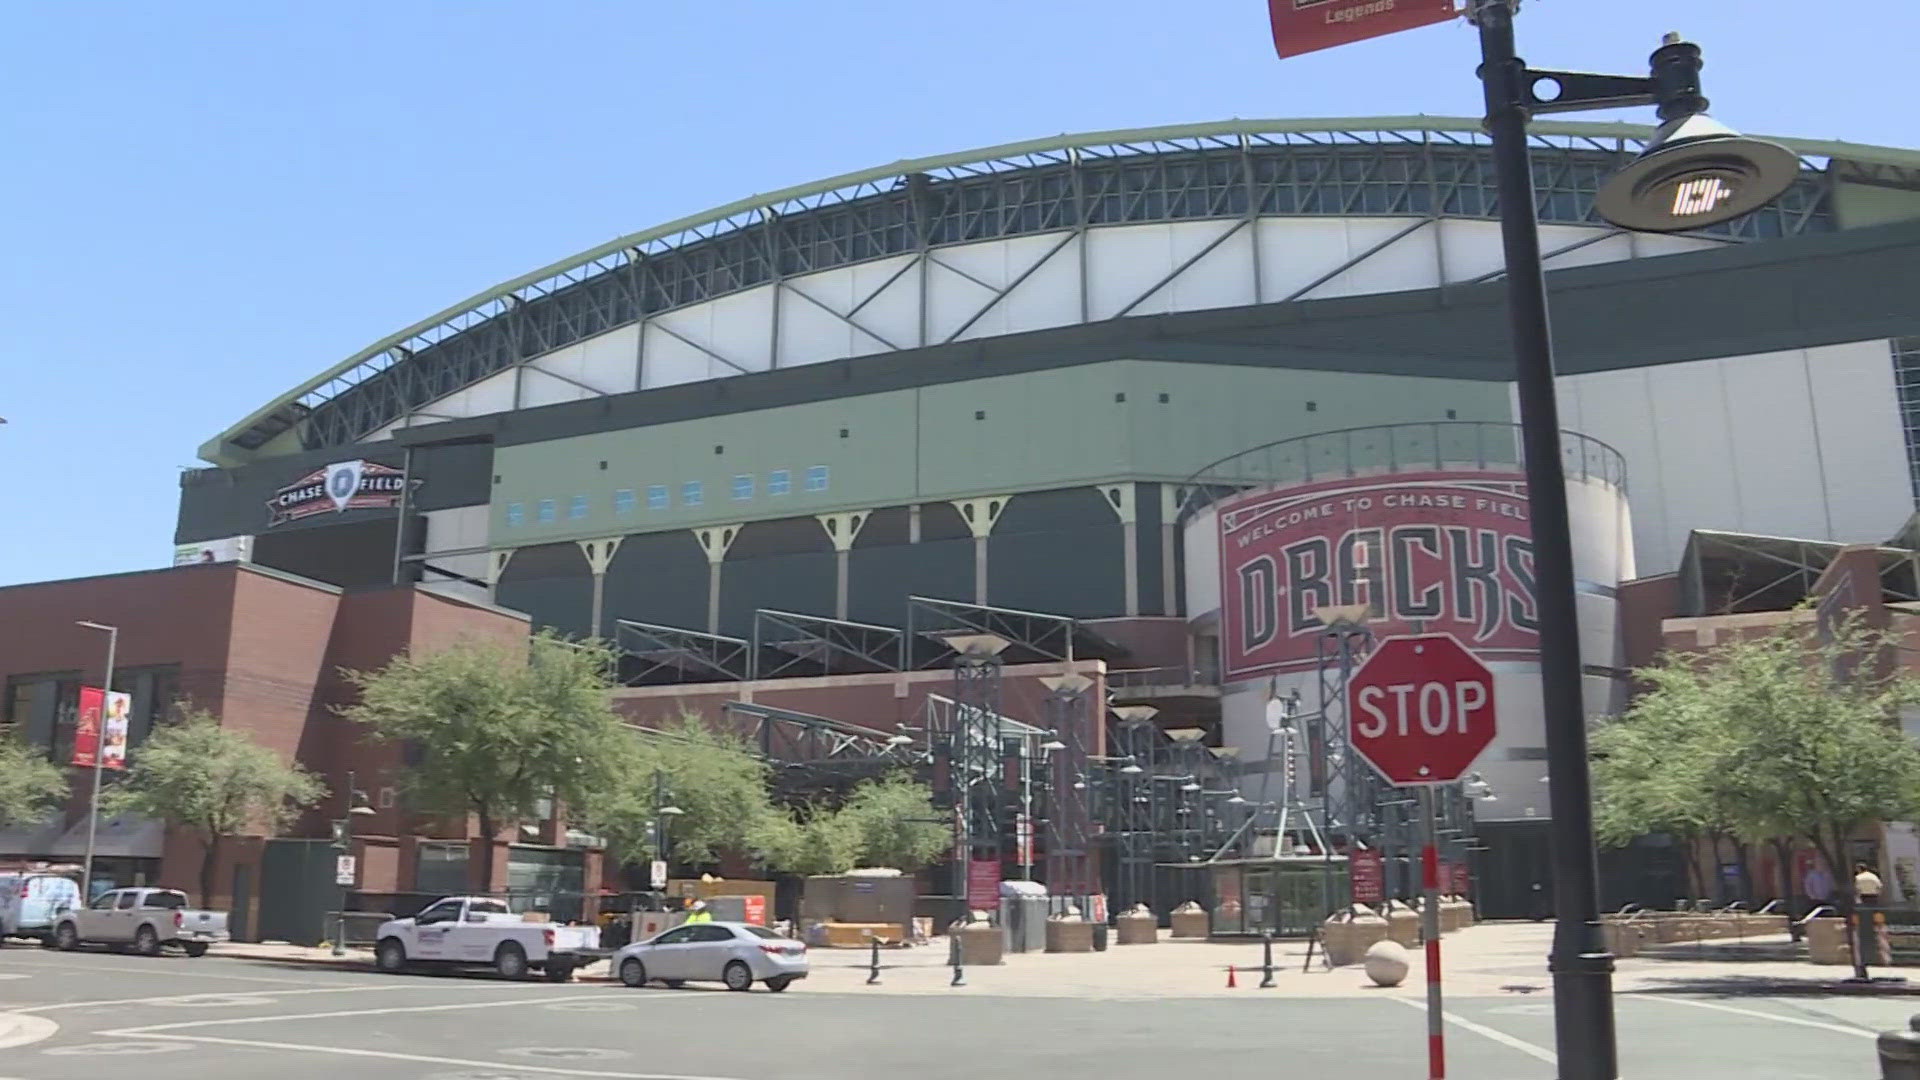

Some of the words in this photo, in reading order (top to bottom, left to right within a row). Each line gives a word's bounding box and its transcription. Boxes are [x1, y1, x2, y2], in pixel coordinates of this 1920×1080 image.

[1325, 0, 1394, 24] Legends
[278, 485, 323, 506] CHASE
[360, 478, 404, 491] FIELD
[1237, 503, 1333, 548] WELCOME
[1342, 498, 1373, 511] TO
[1383, 494, 1466, 508] CHASE
[1476, 498, 1529, 520] FIEL
[1357, 681, 1487, 738] STOP
